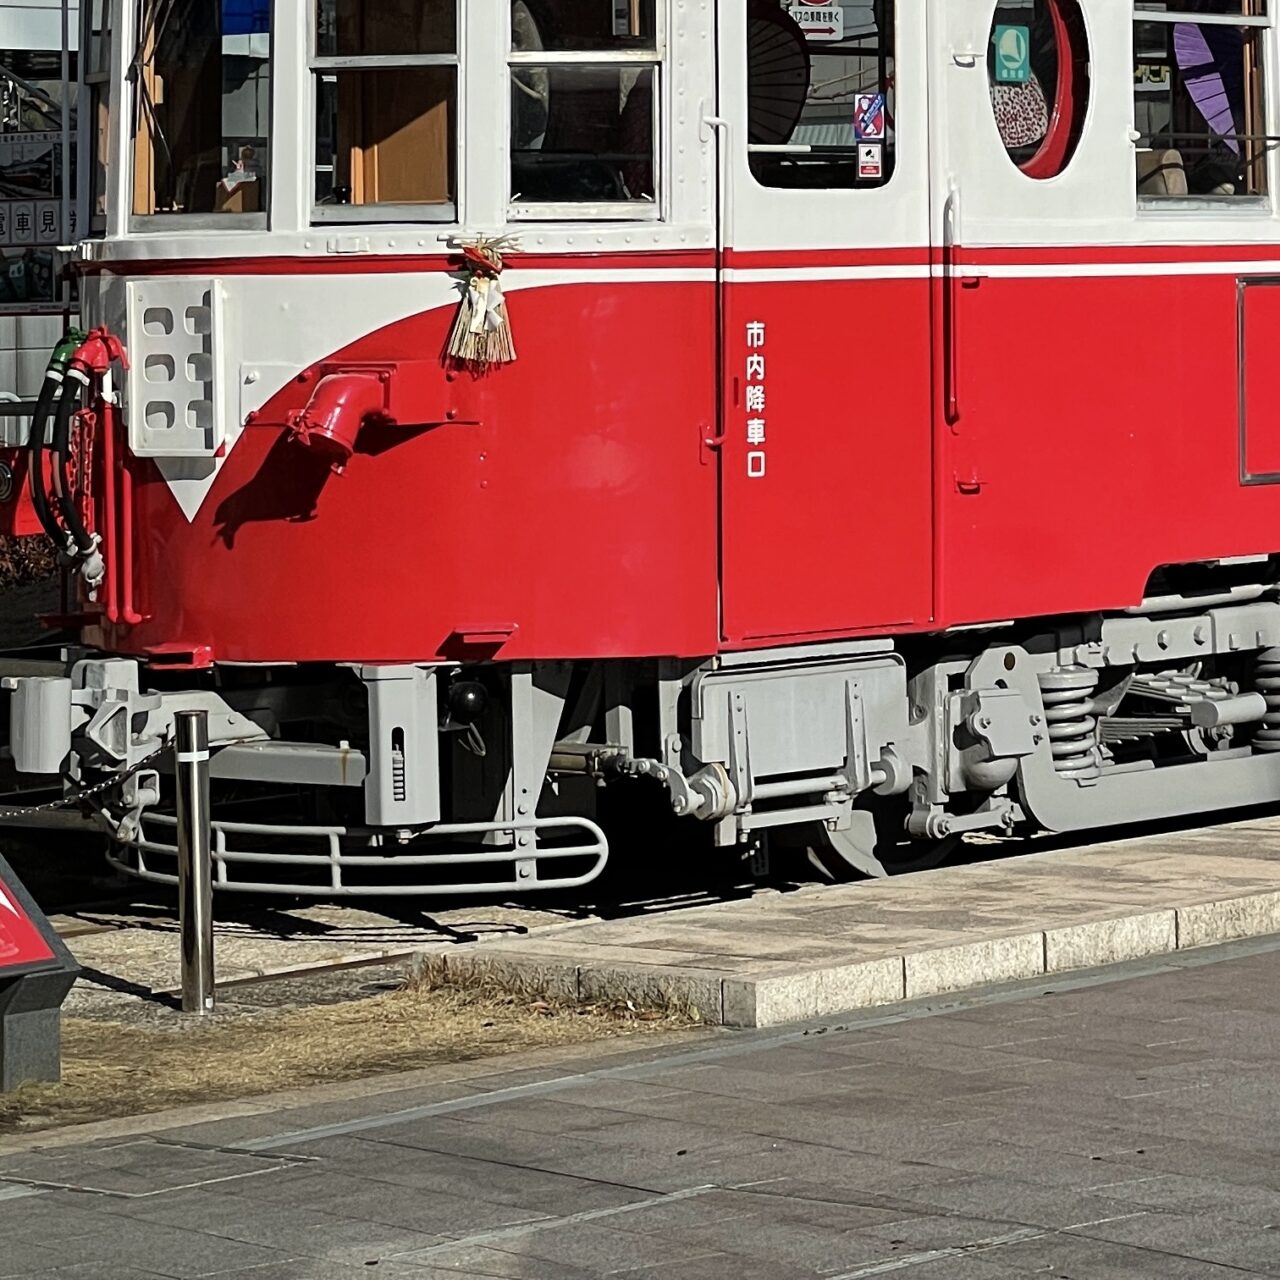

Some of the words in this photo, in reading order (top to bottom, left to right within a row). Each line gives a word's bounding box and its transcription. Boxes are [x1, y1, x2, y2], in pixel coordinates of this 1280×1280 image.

[746, 321, 765, 477] 市内降車口
